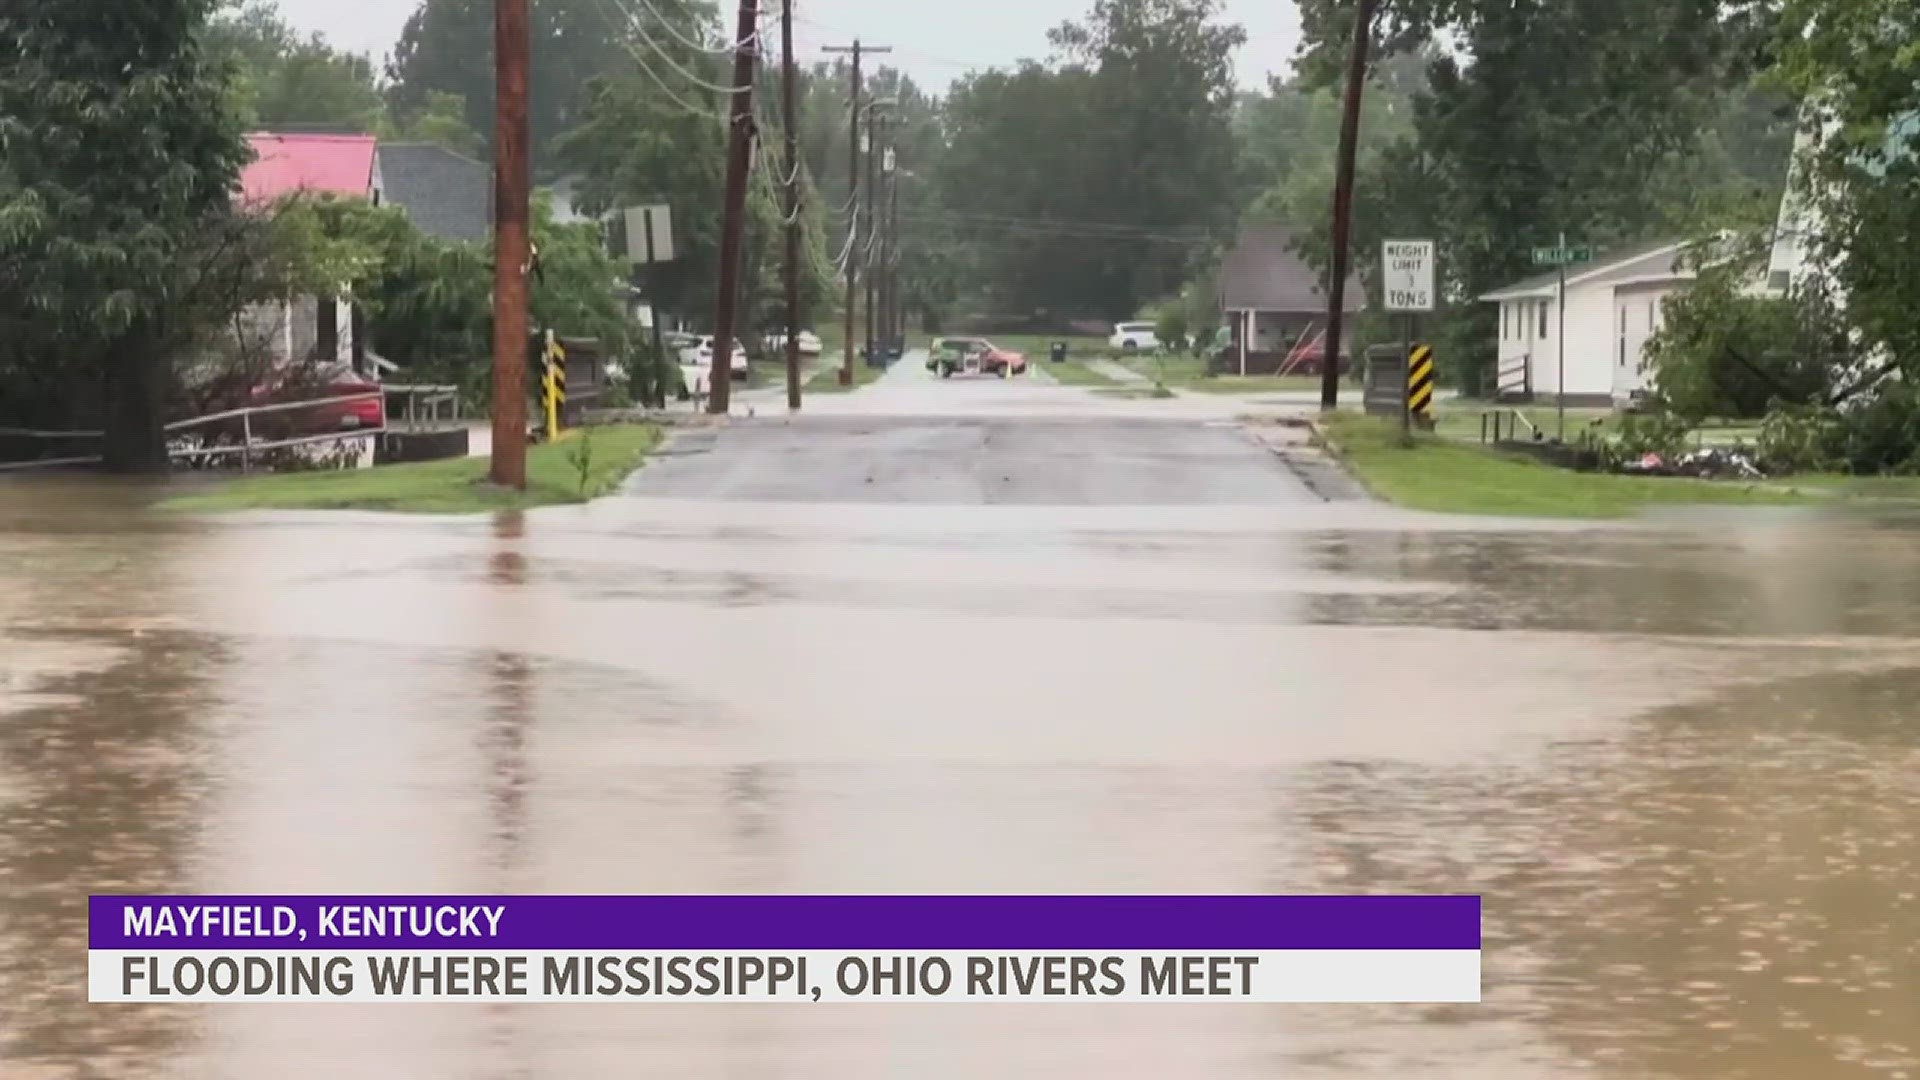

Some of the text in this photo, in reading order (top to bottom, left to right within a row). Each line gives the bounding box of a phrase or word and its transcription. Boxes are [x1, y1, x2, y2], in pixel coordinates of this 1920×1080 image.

[1387, 244, 1428, 257] WEIGHT
[1392, 259, 1421, 271] LIMIT
[1389, 290, 1427, 306] TONS
